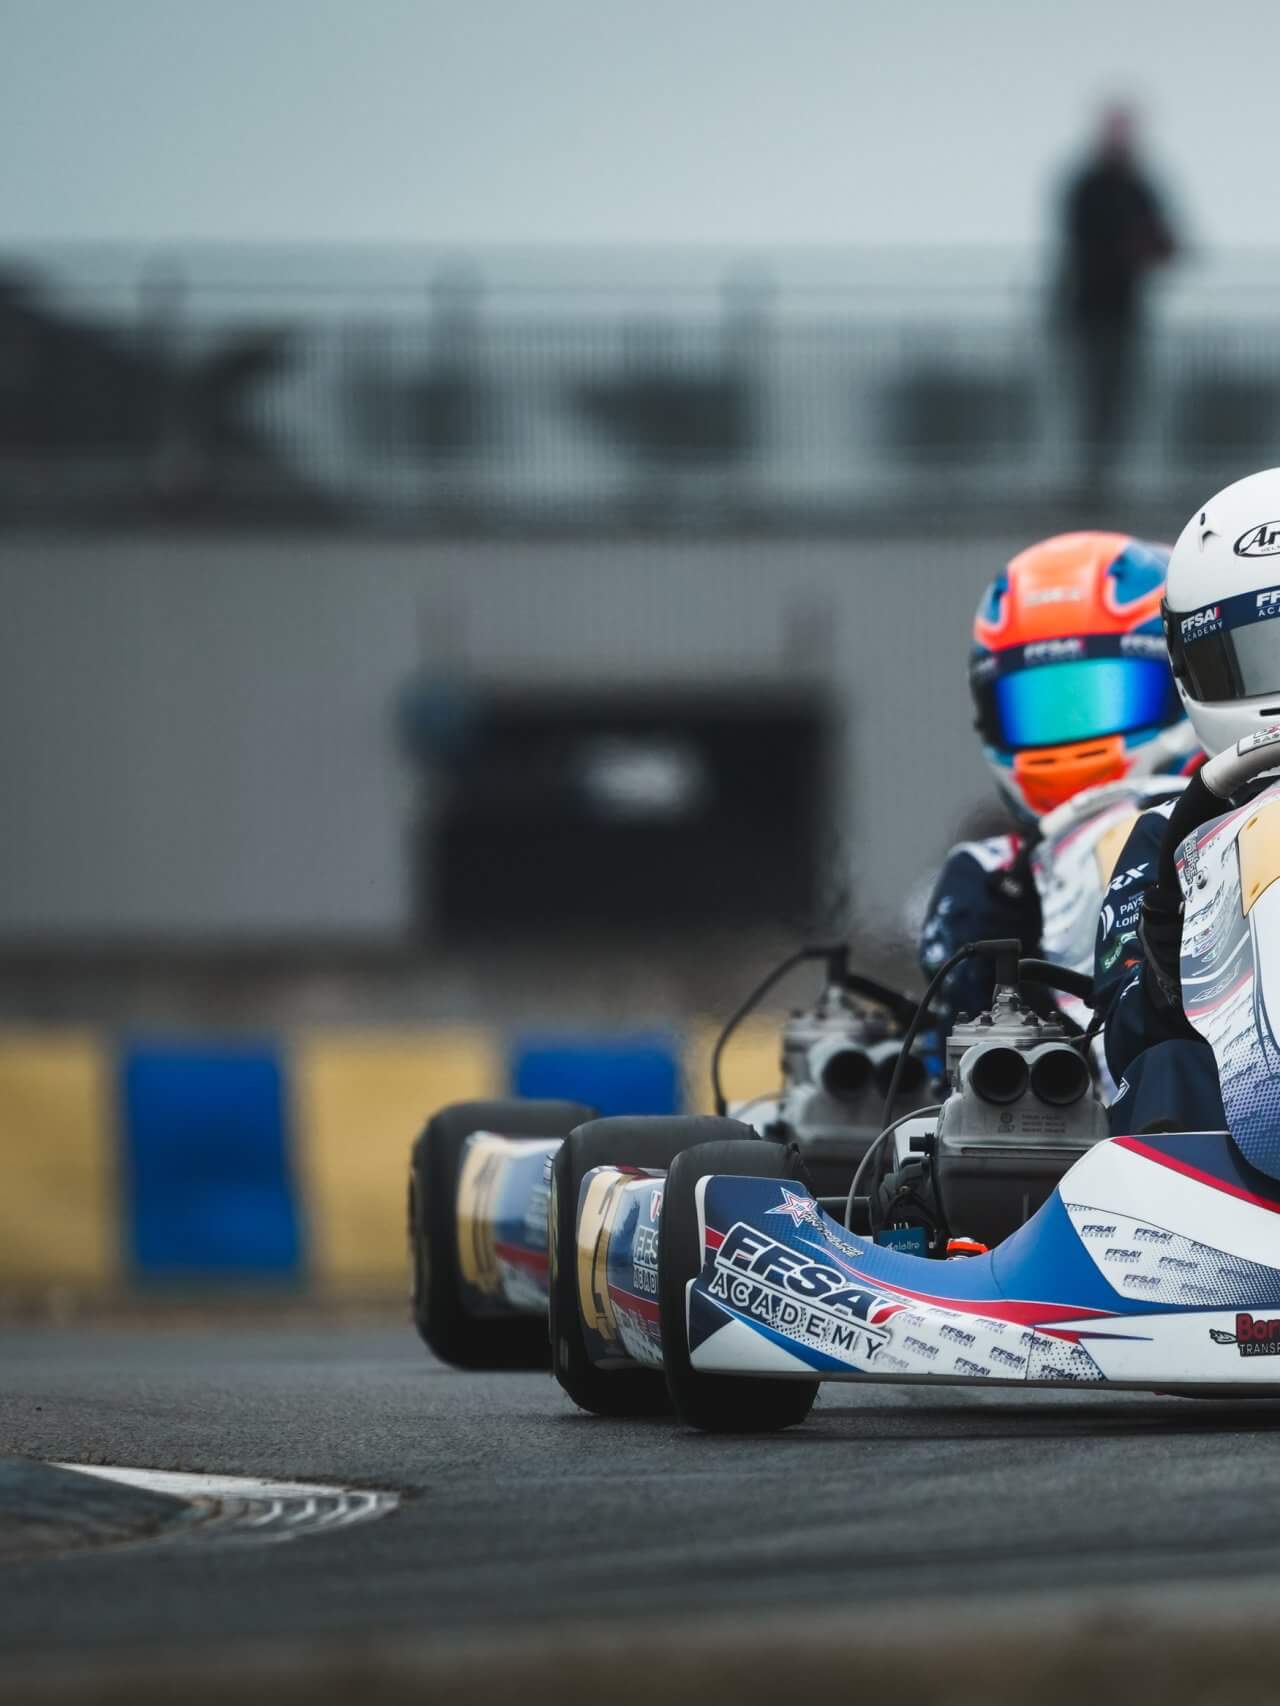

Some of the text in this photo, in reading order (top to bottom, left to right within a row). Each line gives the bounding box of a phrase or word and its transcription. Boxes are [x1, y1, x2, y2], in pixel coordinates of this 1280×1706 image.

[1181, 607, 1218, 634] FFSA
[1184, 621, 1222, 643] ACADEMY
[1104, 862, 1150, 898] RX
[1081, 1225, 1115, 1233] FFSA
[1134, 1228, 1171, 1240] FFSA
[1105, 1249, 1141, 1258] FFSA
[717, 1225, 876, 1322] FFSA
[1124, 1274, 1160, 1285] FFSA
[709, 1268, 883, 1360] ACADEMY
[941, 1325, 976, 1343] FFSA
[904, 1336, 940, 1354] FFSA
[990, 1347, 1026, 1364] FFSA
[956, 1357, 991, 1376] FFSA
